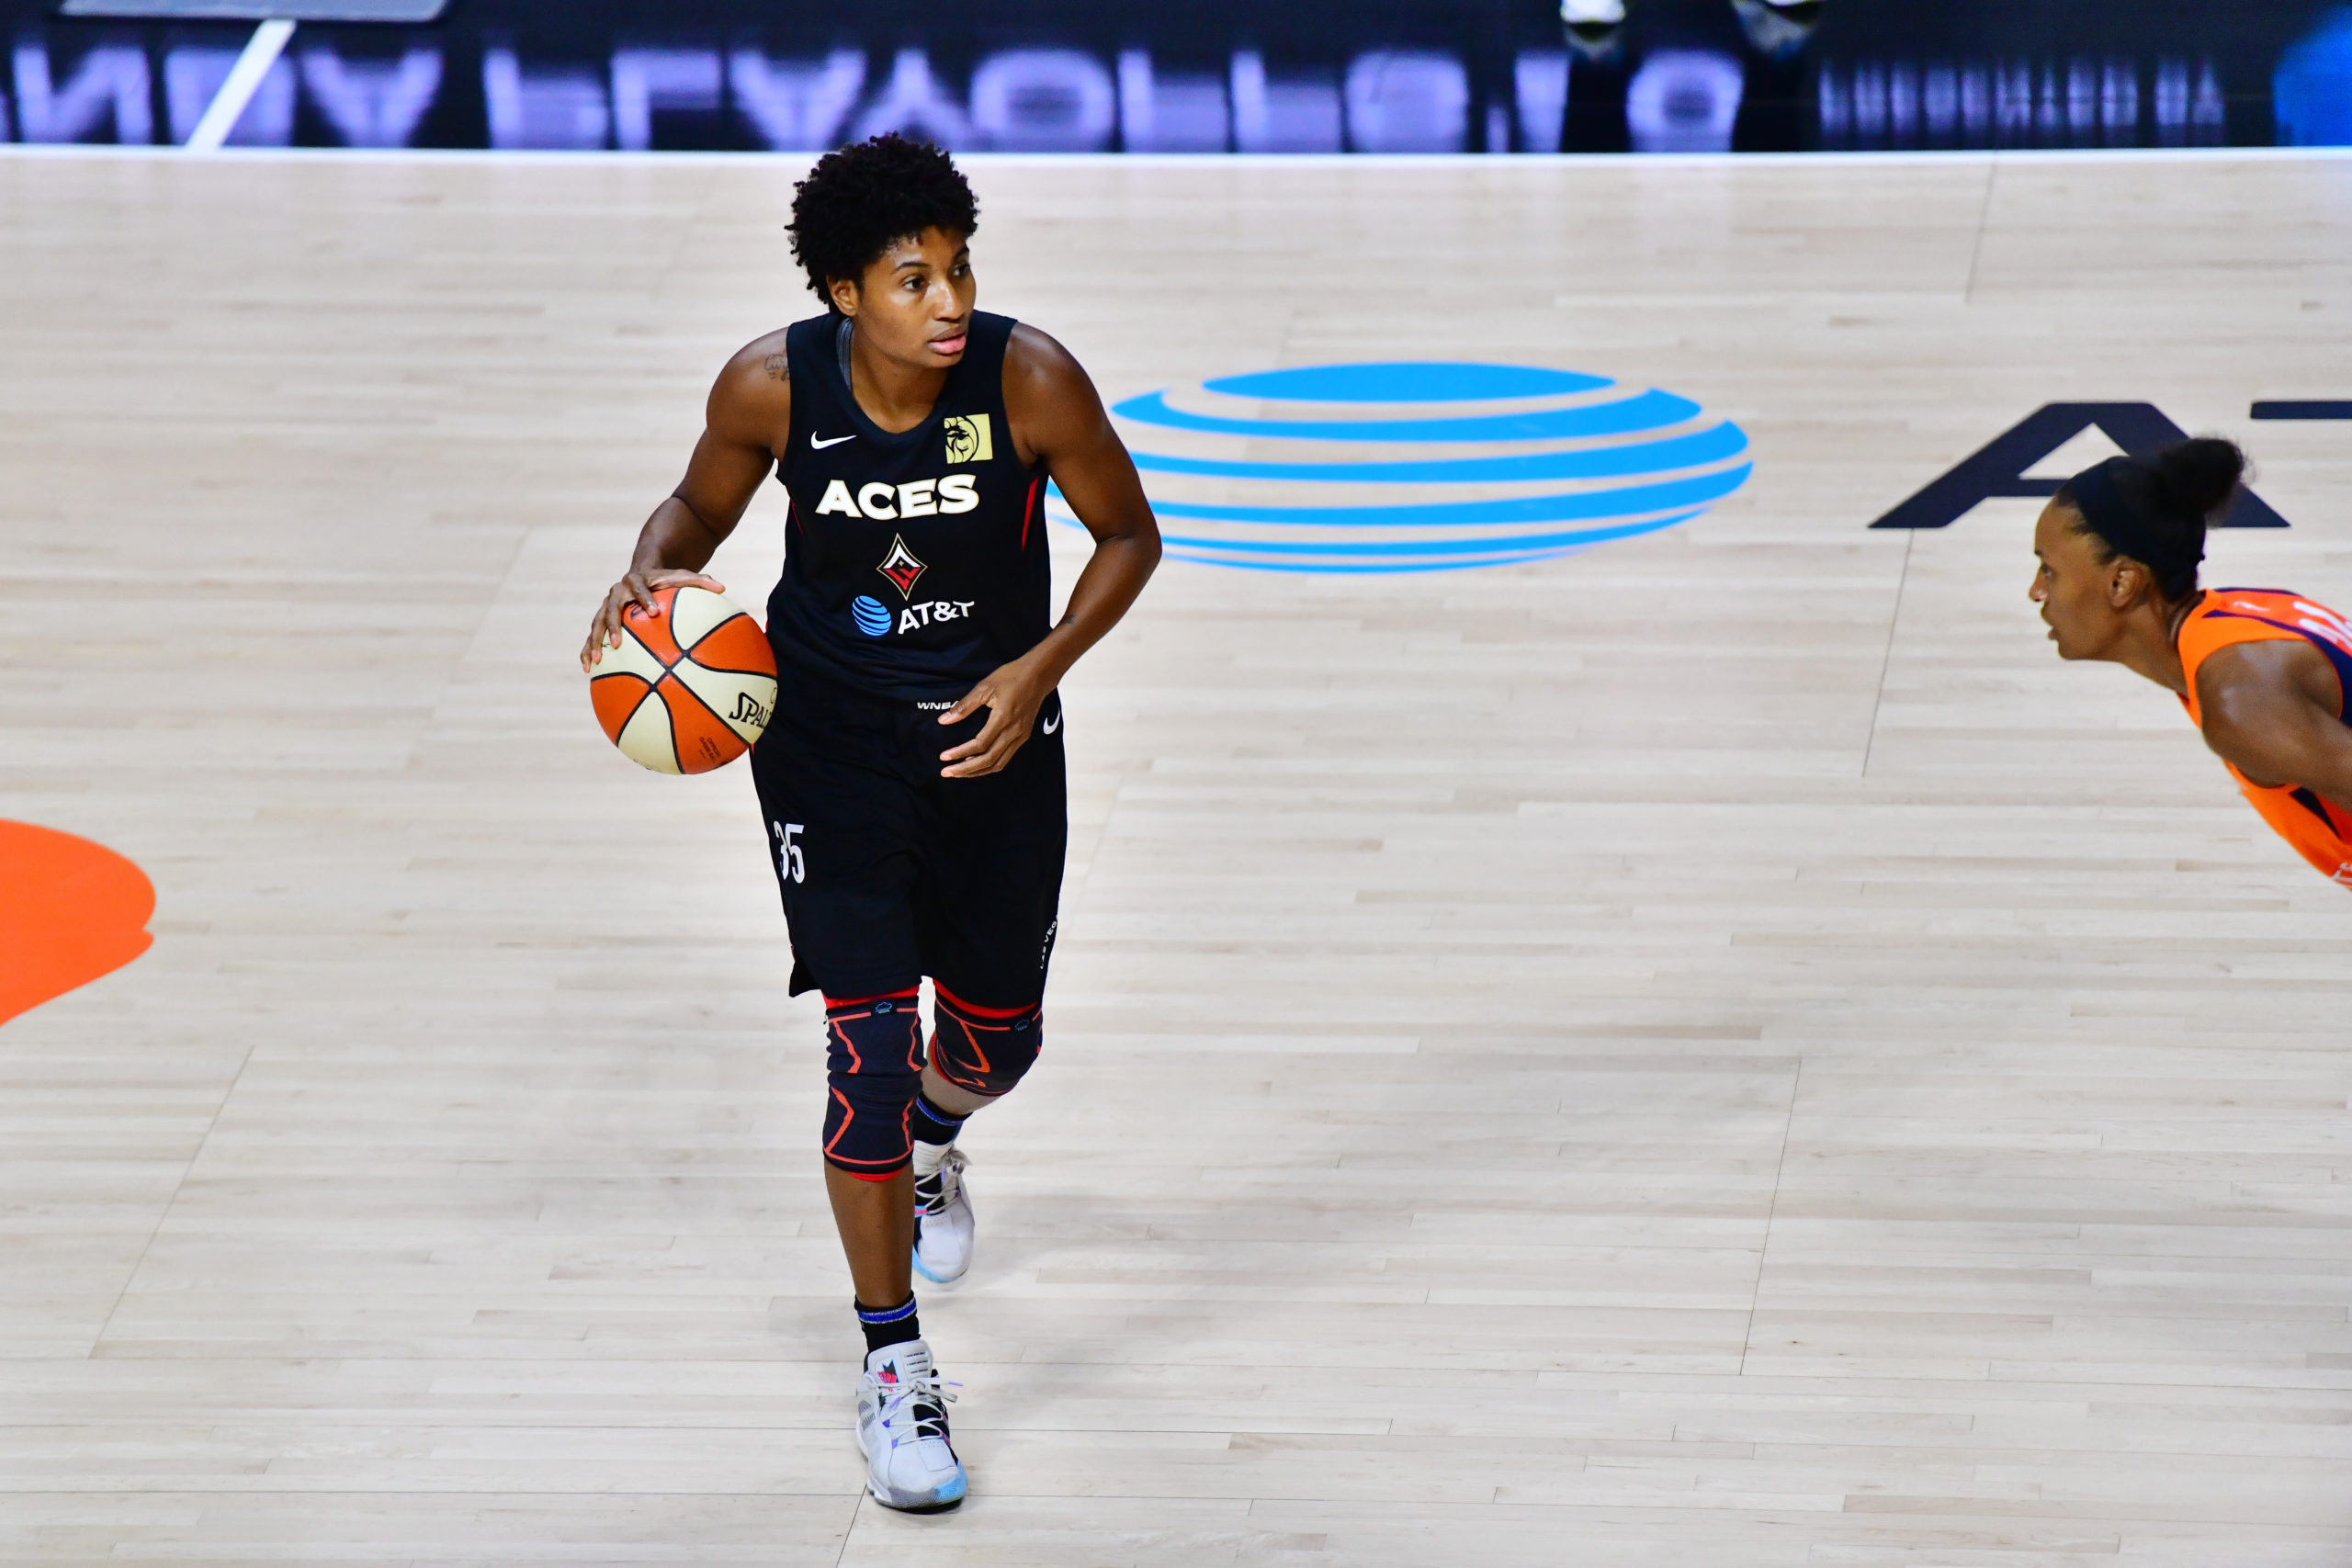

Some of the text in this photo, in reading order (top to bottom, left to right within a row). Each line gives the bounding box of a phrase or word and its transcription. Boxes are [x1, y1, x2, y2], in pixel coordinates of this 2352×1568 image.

[815, 474, 979, 521] ACES
[898, 600, 975, 635] AT&T
[729, 692, 773, 728] SPAL
[774, 820, 806, 884] 35
